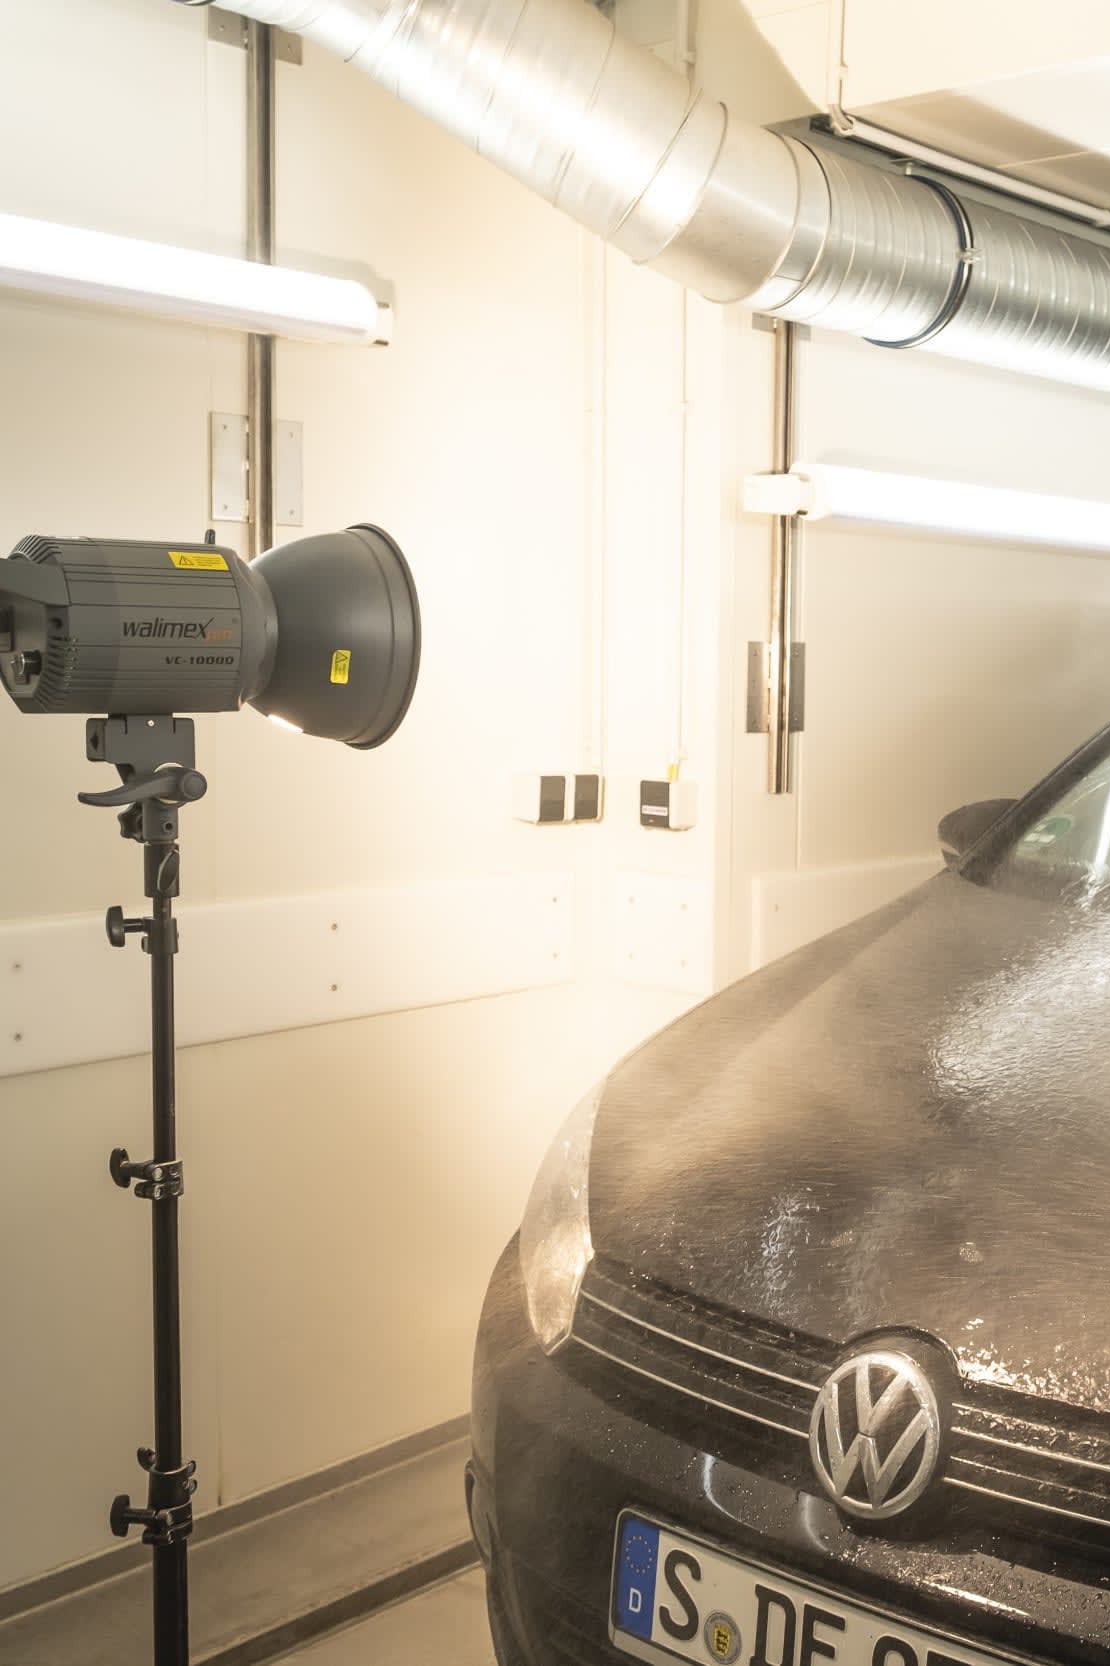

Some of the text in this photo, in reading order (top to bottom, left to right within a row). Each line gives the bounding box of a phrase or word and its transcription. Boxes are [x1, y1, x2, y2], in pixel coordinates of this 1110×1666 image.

[123, 617, 214, 639] walimex
[629, 1587, 641, 1613] D
[659, 1549, 701, 1641] S
